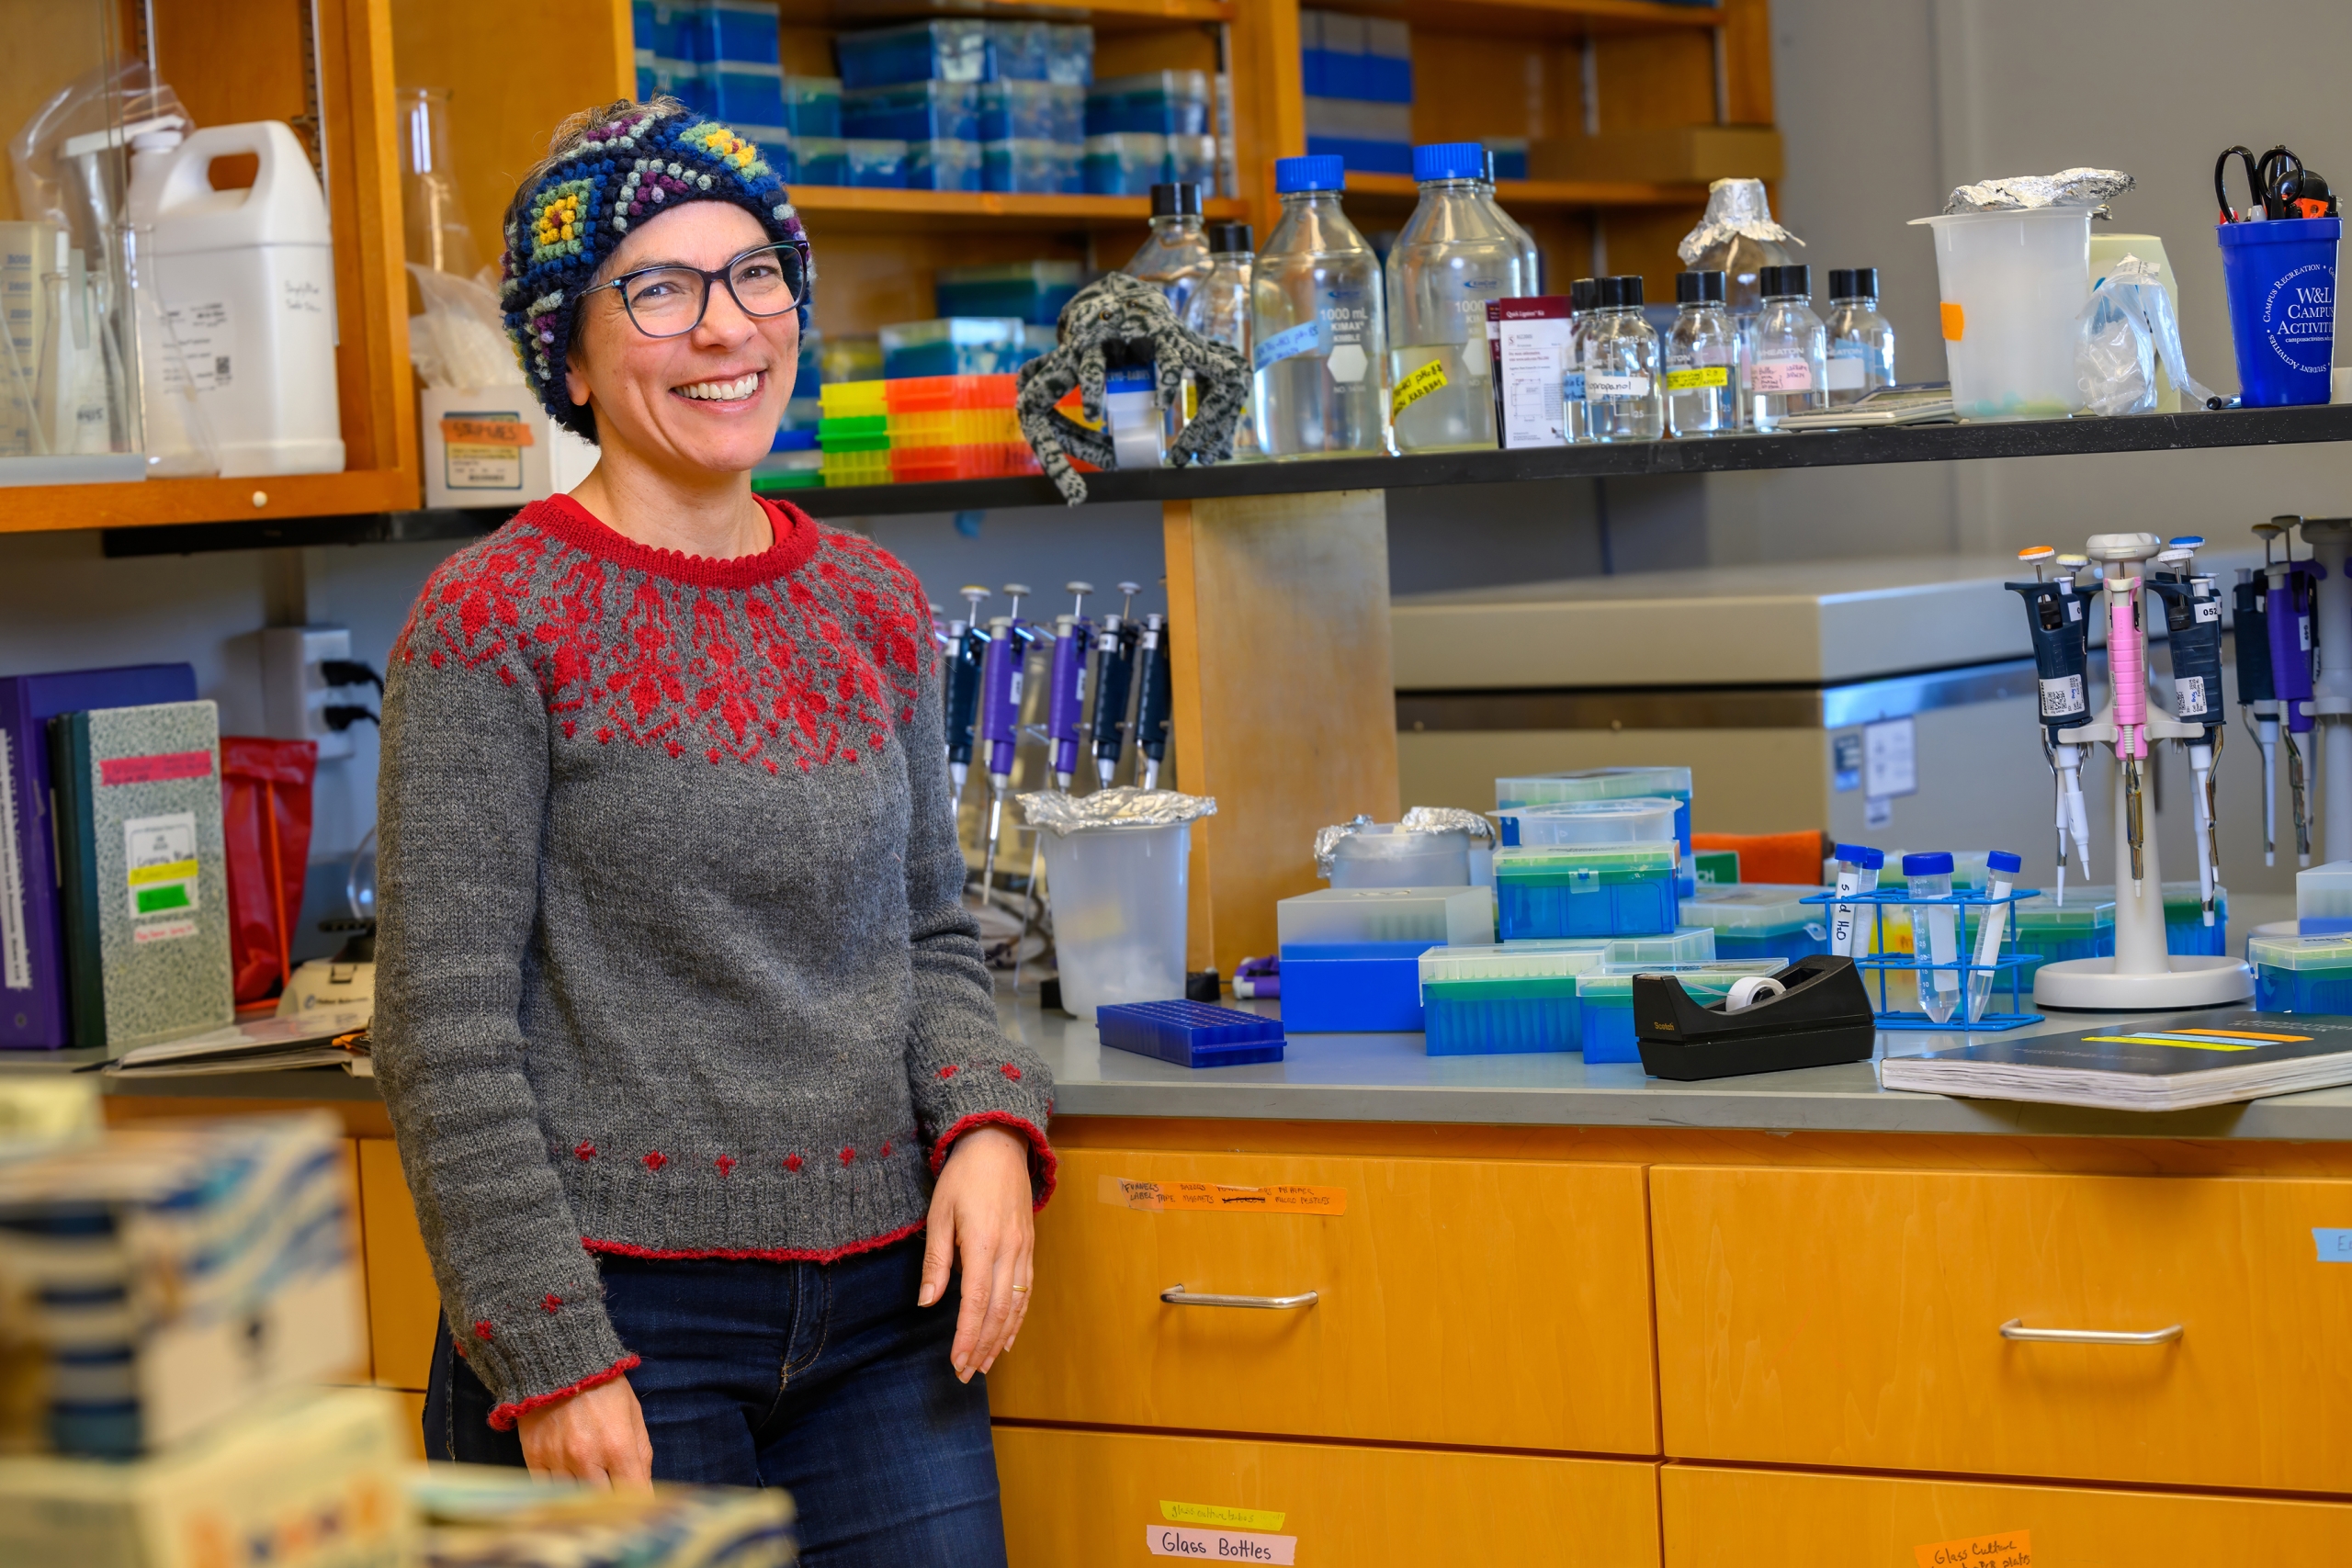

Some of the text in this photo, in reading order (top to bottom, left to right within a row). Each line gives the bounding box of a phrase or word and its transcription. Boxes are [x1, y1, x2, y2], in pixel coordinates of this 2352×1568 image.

[2263, 264, 2321, 322] CAMPUS RECREATION
[2296, 287, 2332, 304] W&L
[1455, 300, 1485, 312] 1000
[1320, 307, 1368, 321] 1000 mL
[2267, 334, 2327, 373] STUDENT ACTIVITIES
[2203, 608, 2218, 616] 052
[1654, 1021, 1675, 1031] Scotch
[1124, 1182, 1159, 1192] FUNNELS
[1130, 1191, 1154, 1201] LABEL
[1162, 1532, 1272, 1560] Glass Bottles
[1934, 1548, 1968, 1564] Glass
